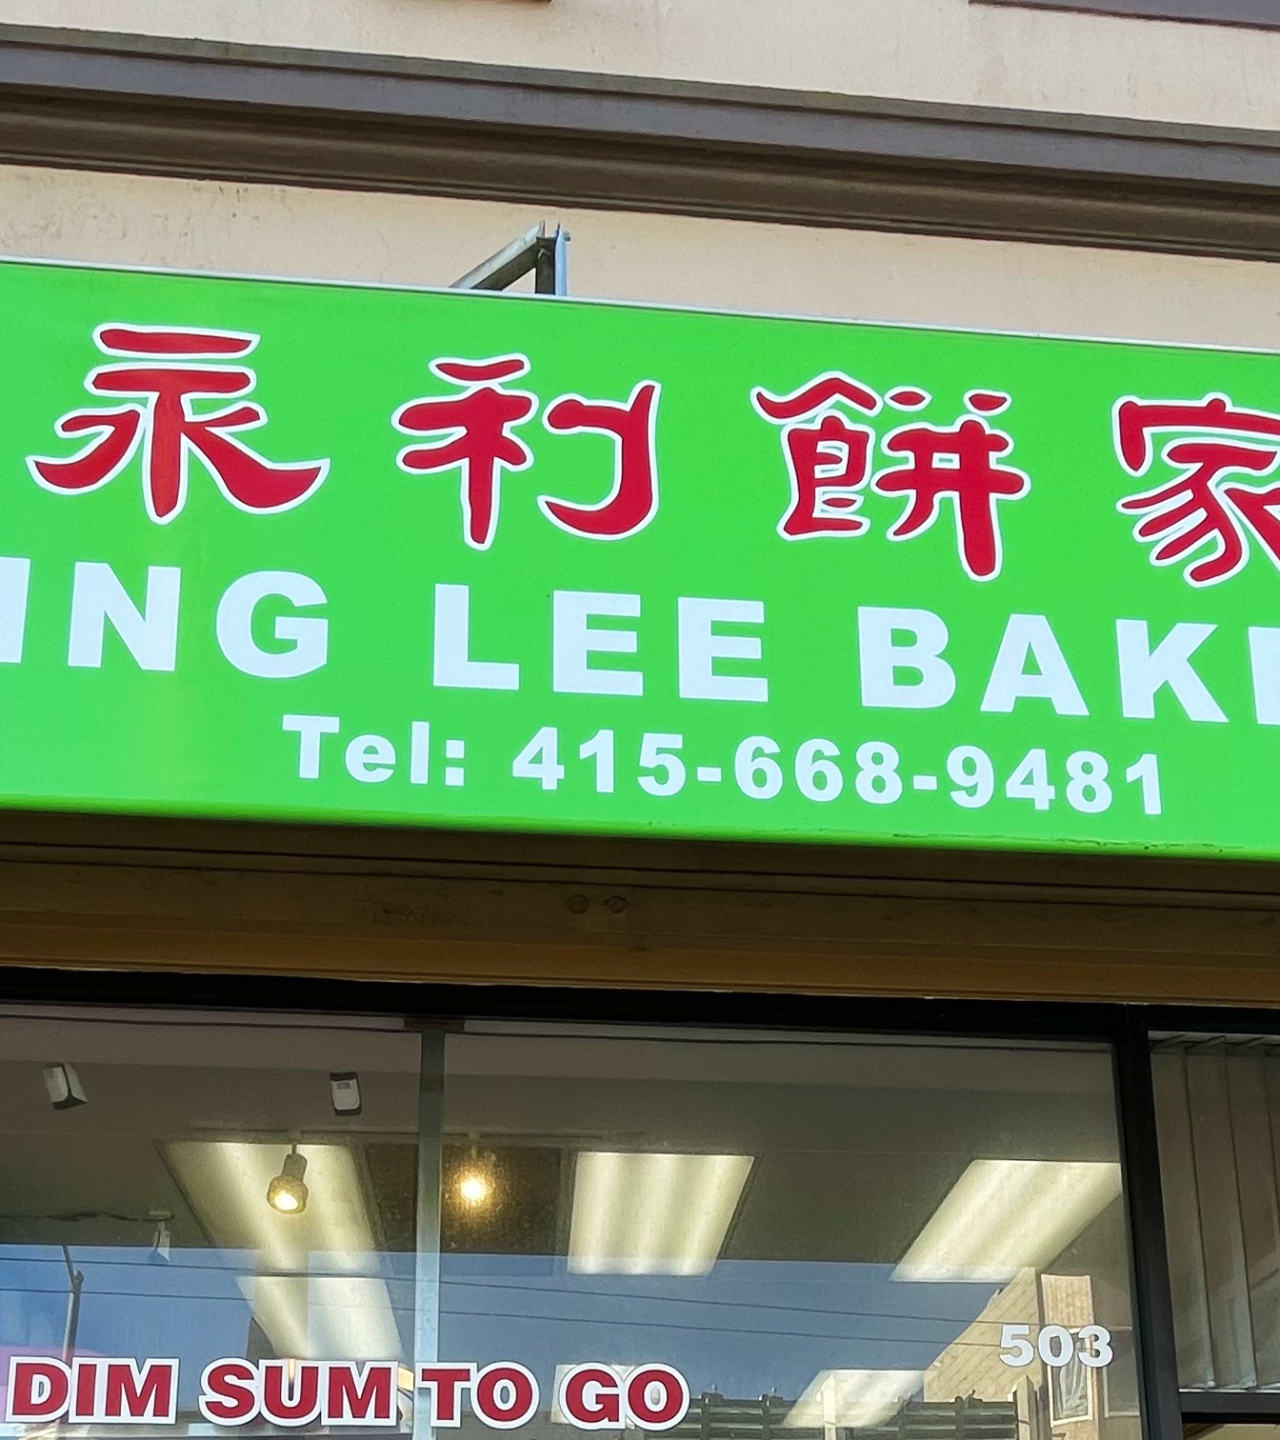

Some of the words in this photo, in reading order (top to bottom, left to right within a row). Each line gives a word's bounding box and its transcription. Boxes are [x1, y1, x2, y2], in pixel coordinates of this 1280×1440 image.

[432, 583, 770, 702] LEE
[282, 713, 466, 787] Tel:
[511, 726, 1163, 816] 415-668-9481
[998, 1323, 1115, 1370] 503
[5, 1355, 180, 1426] DIM
[199, 1356, 401, 1428] SUM
[416, 1360, 540, 1432] TO
[557, 1361, 691, 1433] GO
